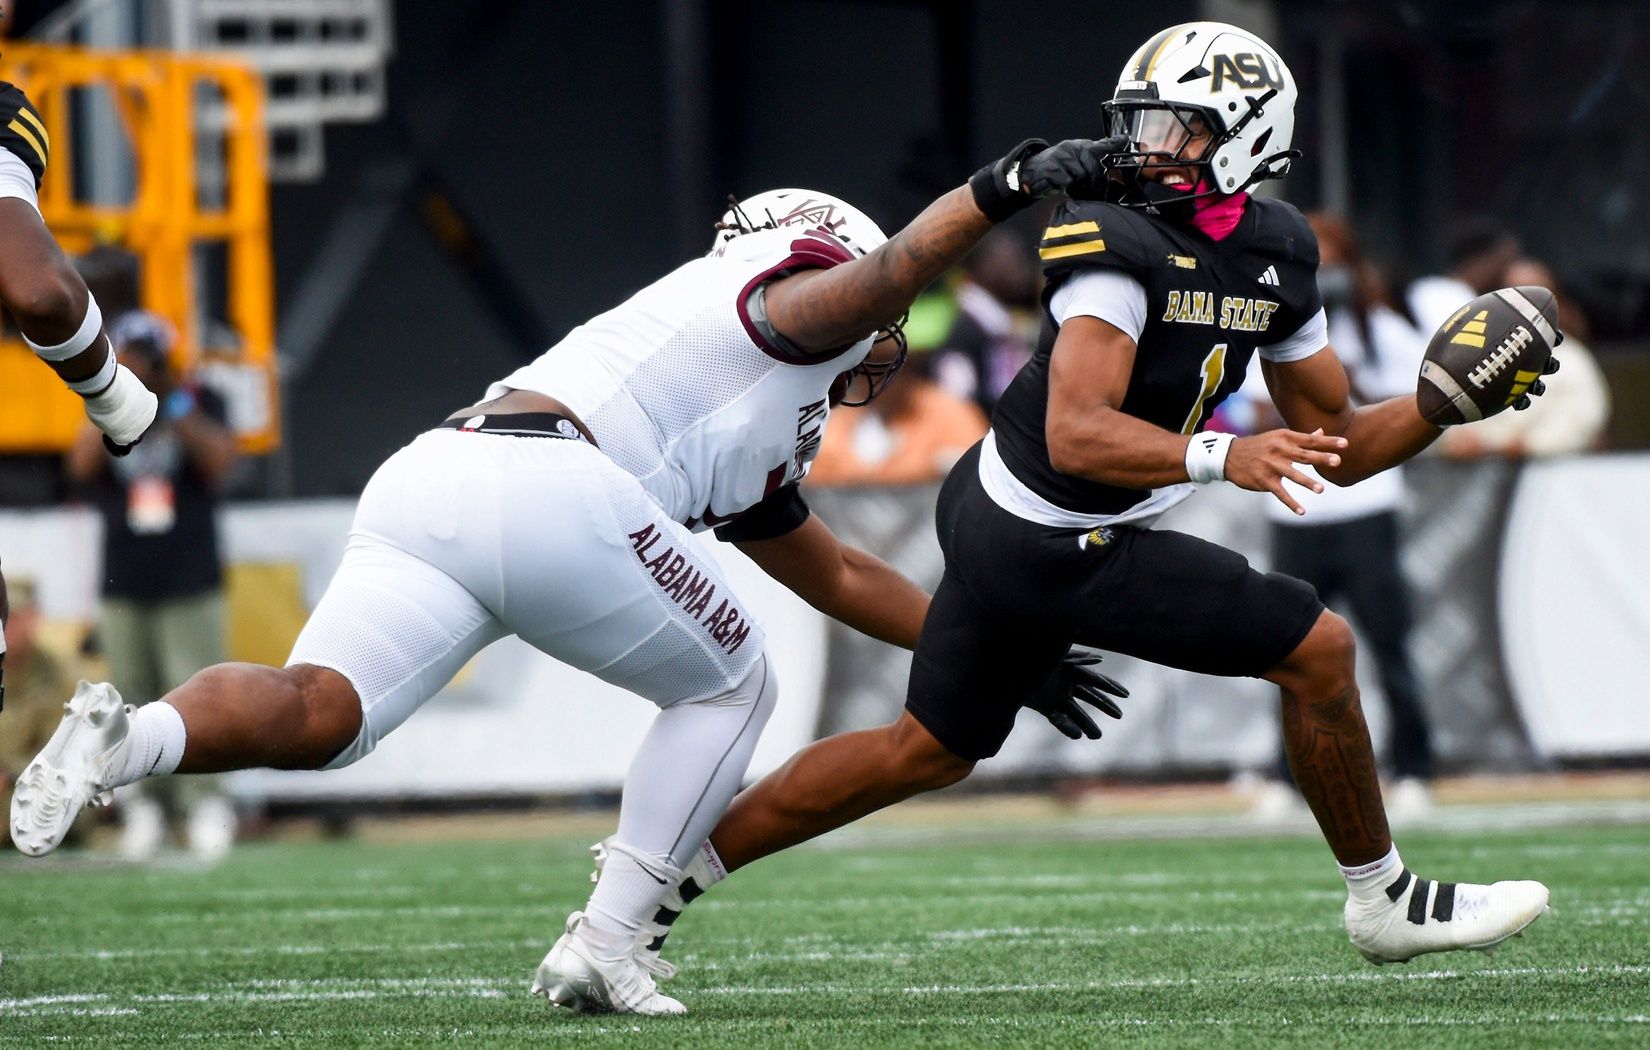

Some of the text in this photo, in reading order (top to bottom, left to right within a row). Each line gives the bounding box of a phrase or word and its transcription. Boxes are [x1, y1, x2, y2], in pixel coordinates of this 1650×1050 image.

[1211, 52, 1285, 93] ASU
[1162, 290, 1280, 331] BAMA STATE
[1181, 344, 1228, 434] 1
[628, 523, 750, 655] ALABAMA A&M
